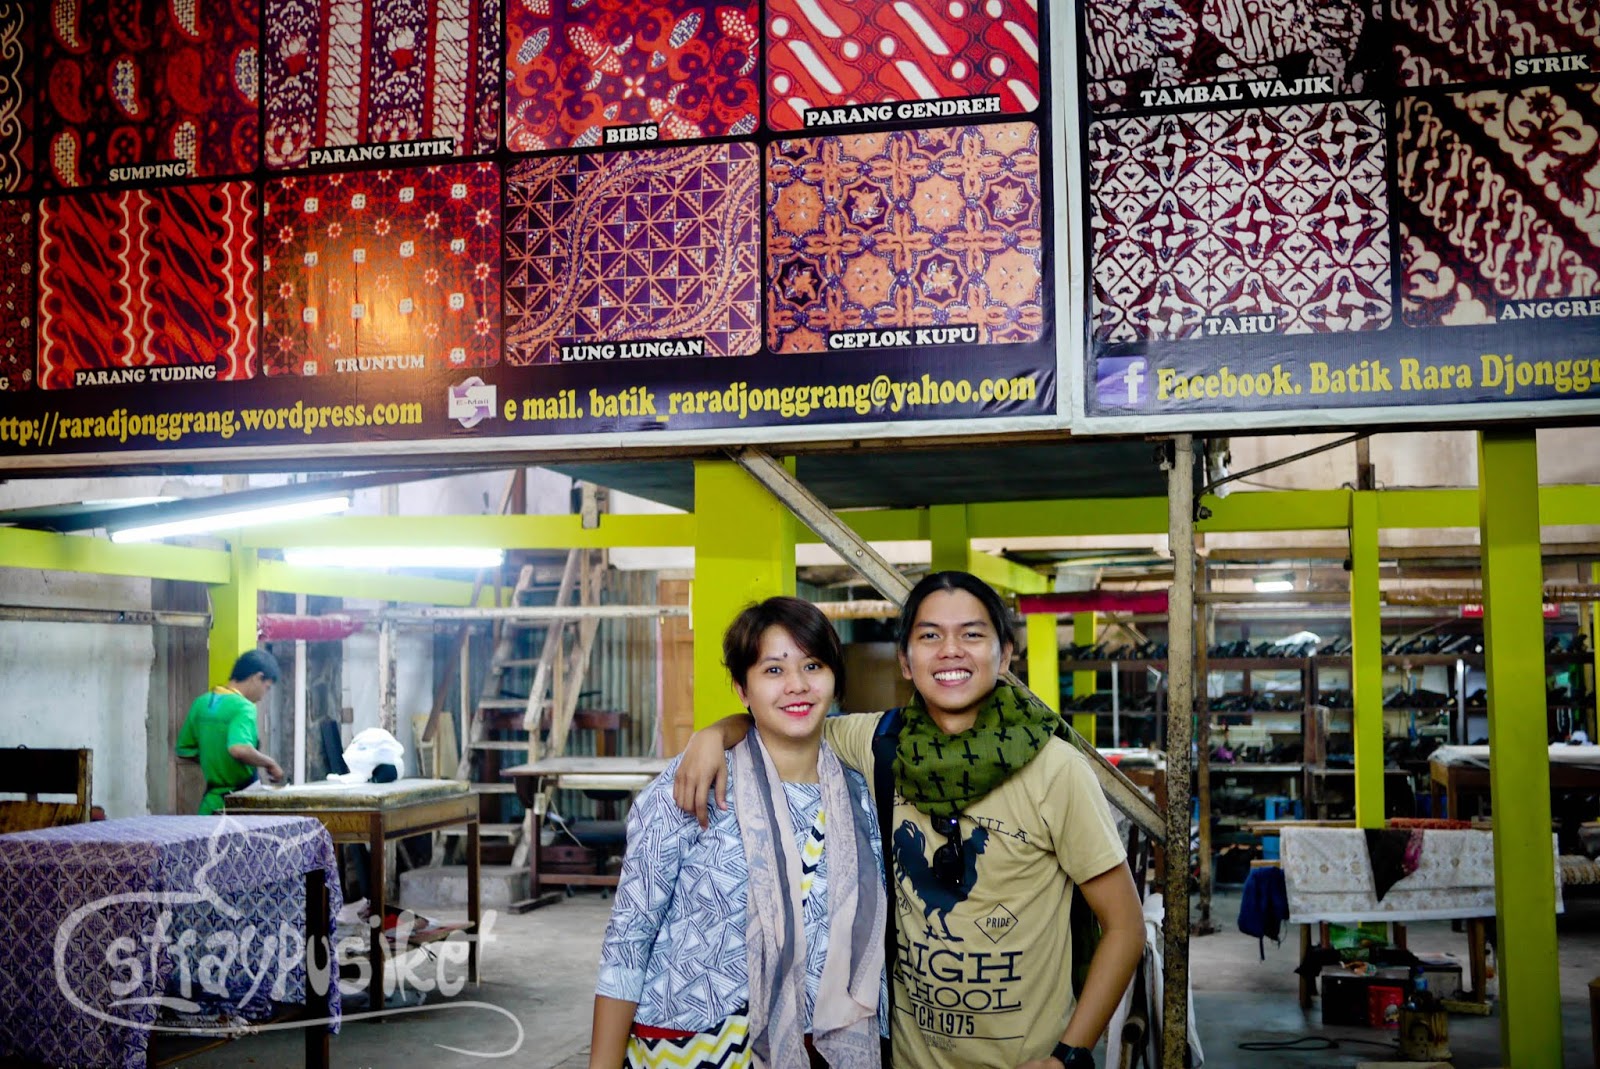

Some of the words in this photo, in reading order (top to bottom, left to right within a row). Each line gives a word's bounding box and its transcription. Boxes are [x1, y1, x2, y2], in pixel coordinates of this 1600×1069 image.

[1515, 54, 1590, 75] STRIK
[1140, 83, 1243, 107] TAMBAL
[1248, 76, 1333, 98] WAJIK
[806, 105, 893, 126] PARANG
[897, 97, 1001, 119] GENDREH
[605, 126, 658, 144] BIBIS
[310, 146, 386, 166] PARANG
[389, 140, 453, 159] KLITIK
[109, 163, 187, 182] SUMPING
[1500, 300, 1600, 320] ANGGRE
[1204, 315, 1277, 336] TAHU
[829, 331, 911, 350] CEPLOK
[916, 327, 978, 345] KUPU
[562, 345, 616, 362] LUNG
[620, 340, 703, 359] LUNGAN
[76, 368, 146, 386] PARANG
[150, 364, 217, 382] TUDING
[334, 355, 425, 373] TRUNTUM
[1157, 363, 1302, 401] Facebook.
[1309, 359, 1393, 395] Batik
[1399, 357, 1473, 391] Rara
[589, 374, 1036, 422] batik_raradjonggrang@yahoo.com
[986, 917, 1011, 928] PRIDE
[938, 1012, 975, 1035] 1975
